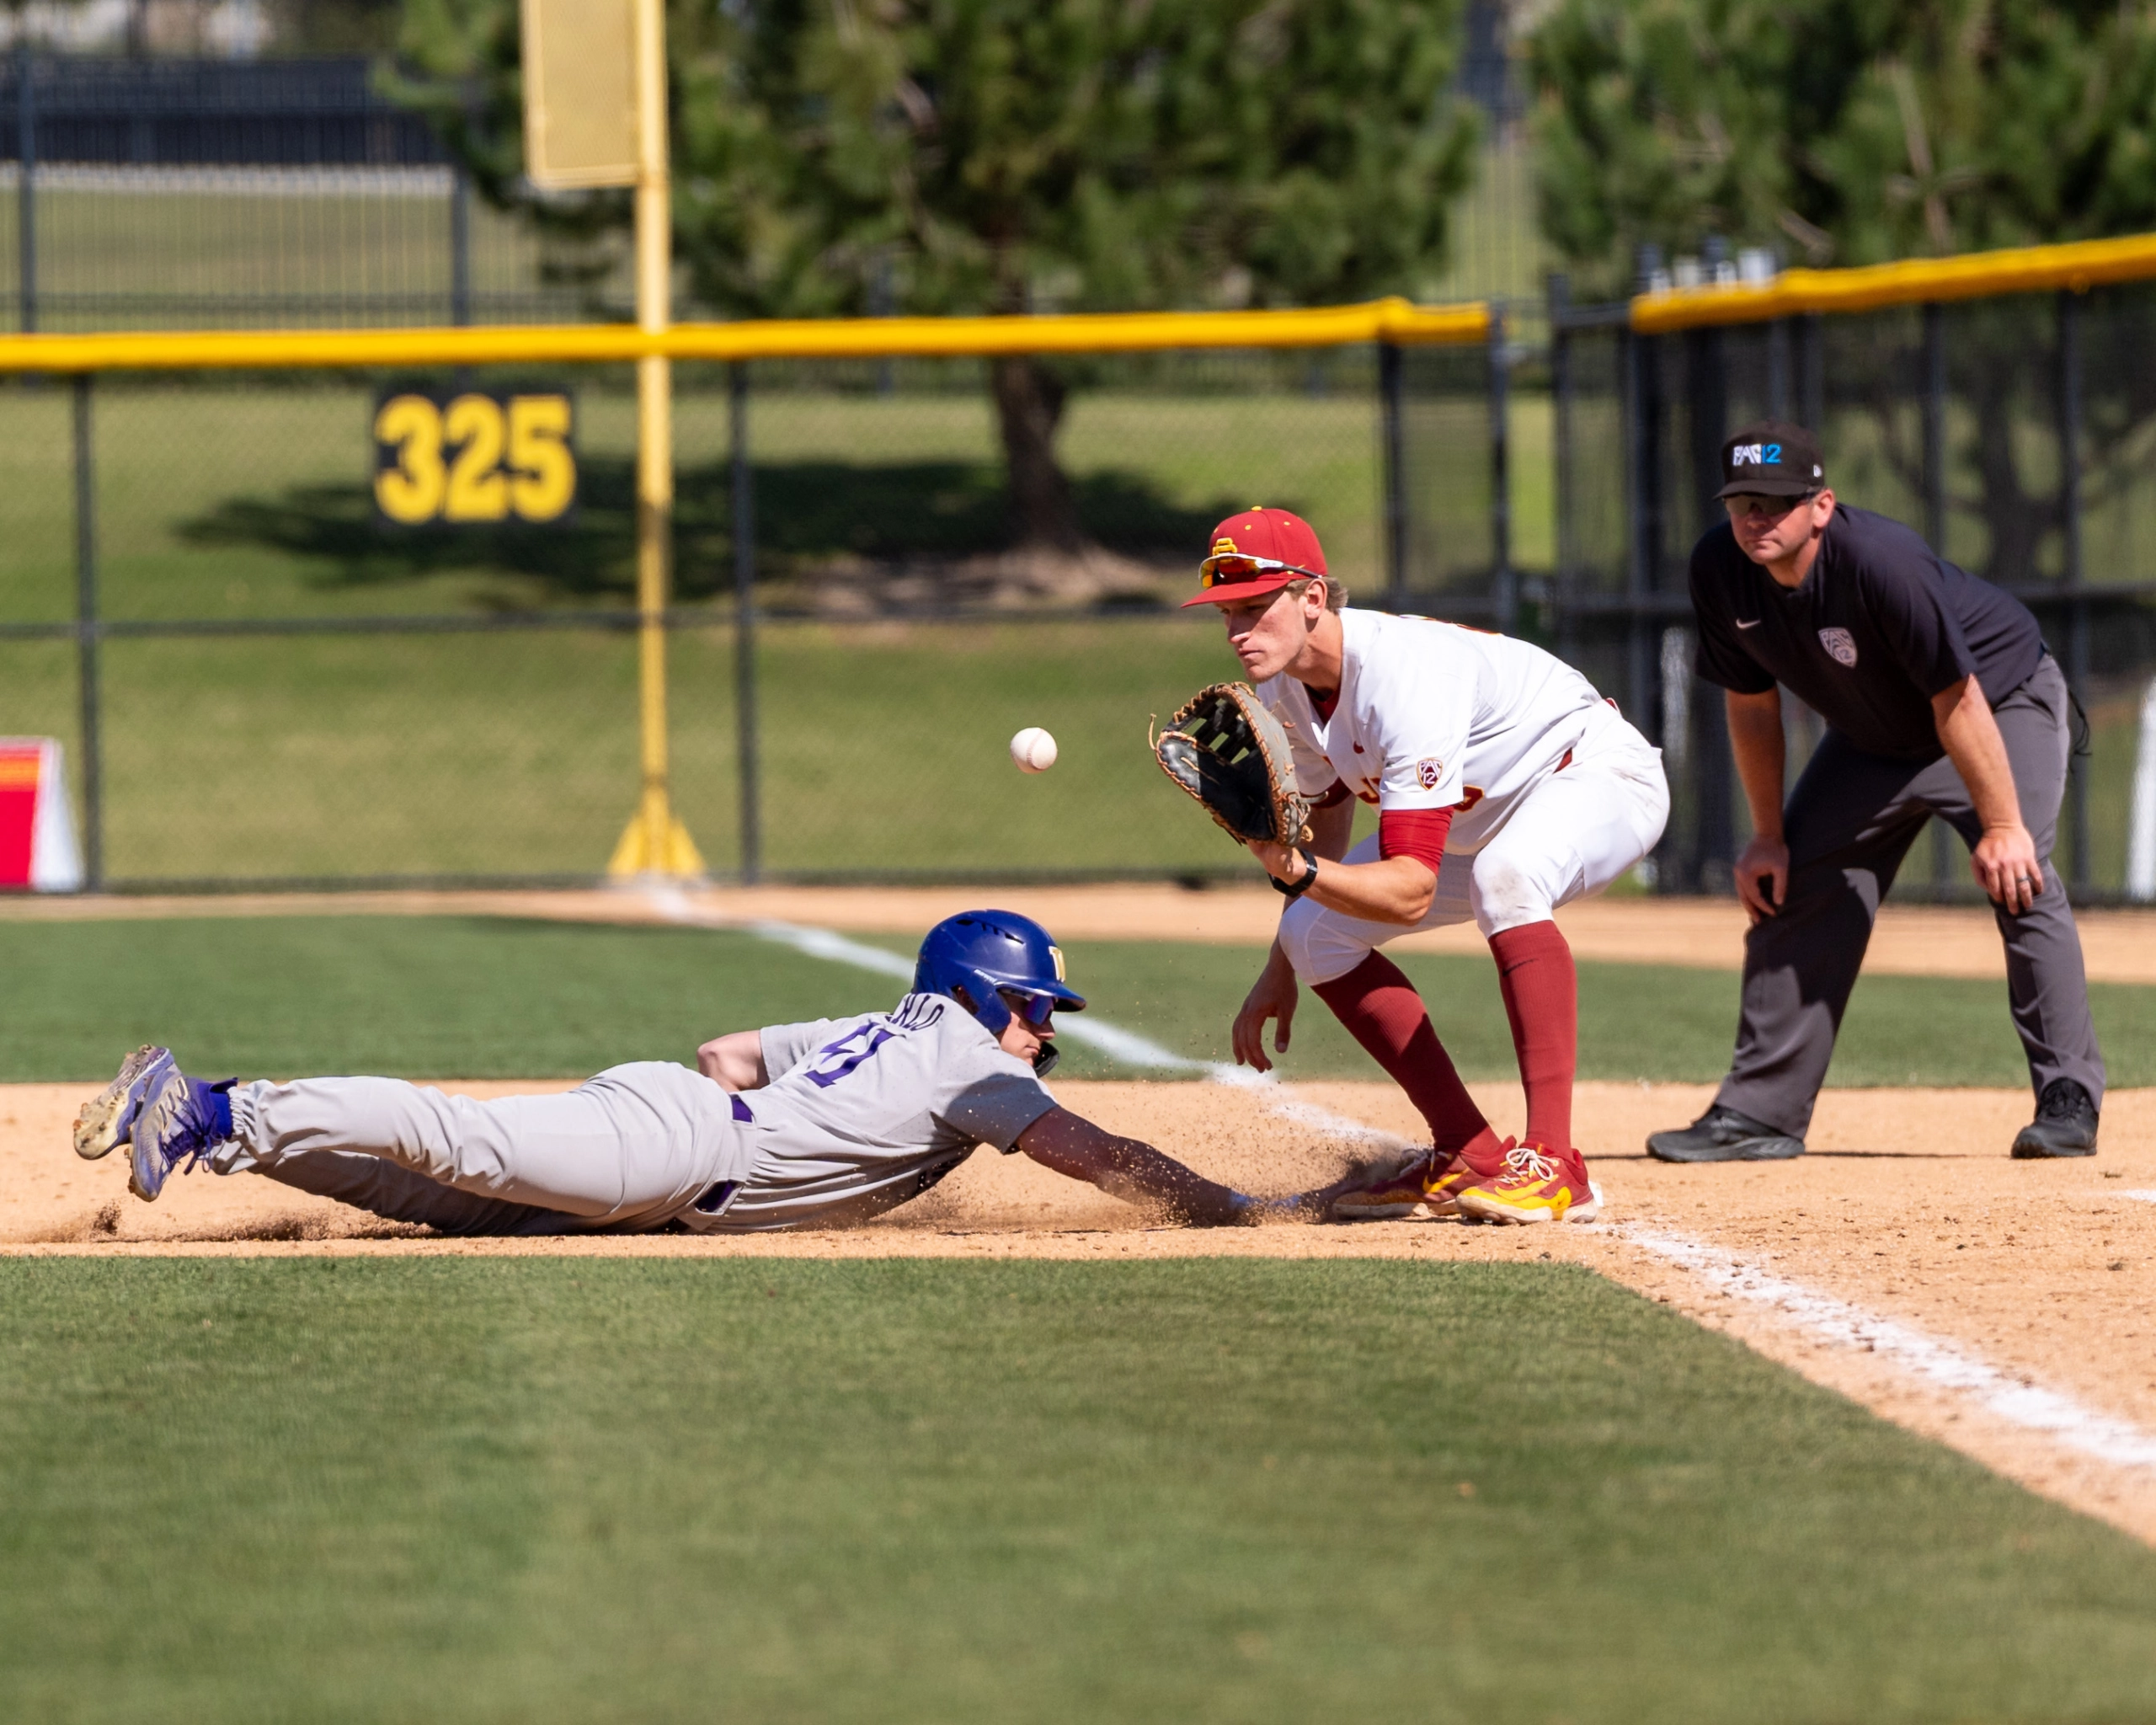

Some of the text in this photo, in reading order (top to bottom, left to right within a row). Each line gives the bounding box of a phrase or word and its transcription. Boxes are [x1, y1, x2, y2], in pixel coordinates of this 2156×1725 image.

[376, 393, 576, 523] 325
[1419, 761, 1442, 779] PAC
[1423, 772, 1436, 784] 12
